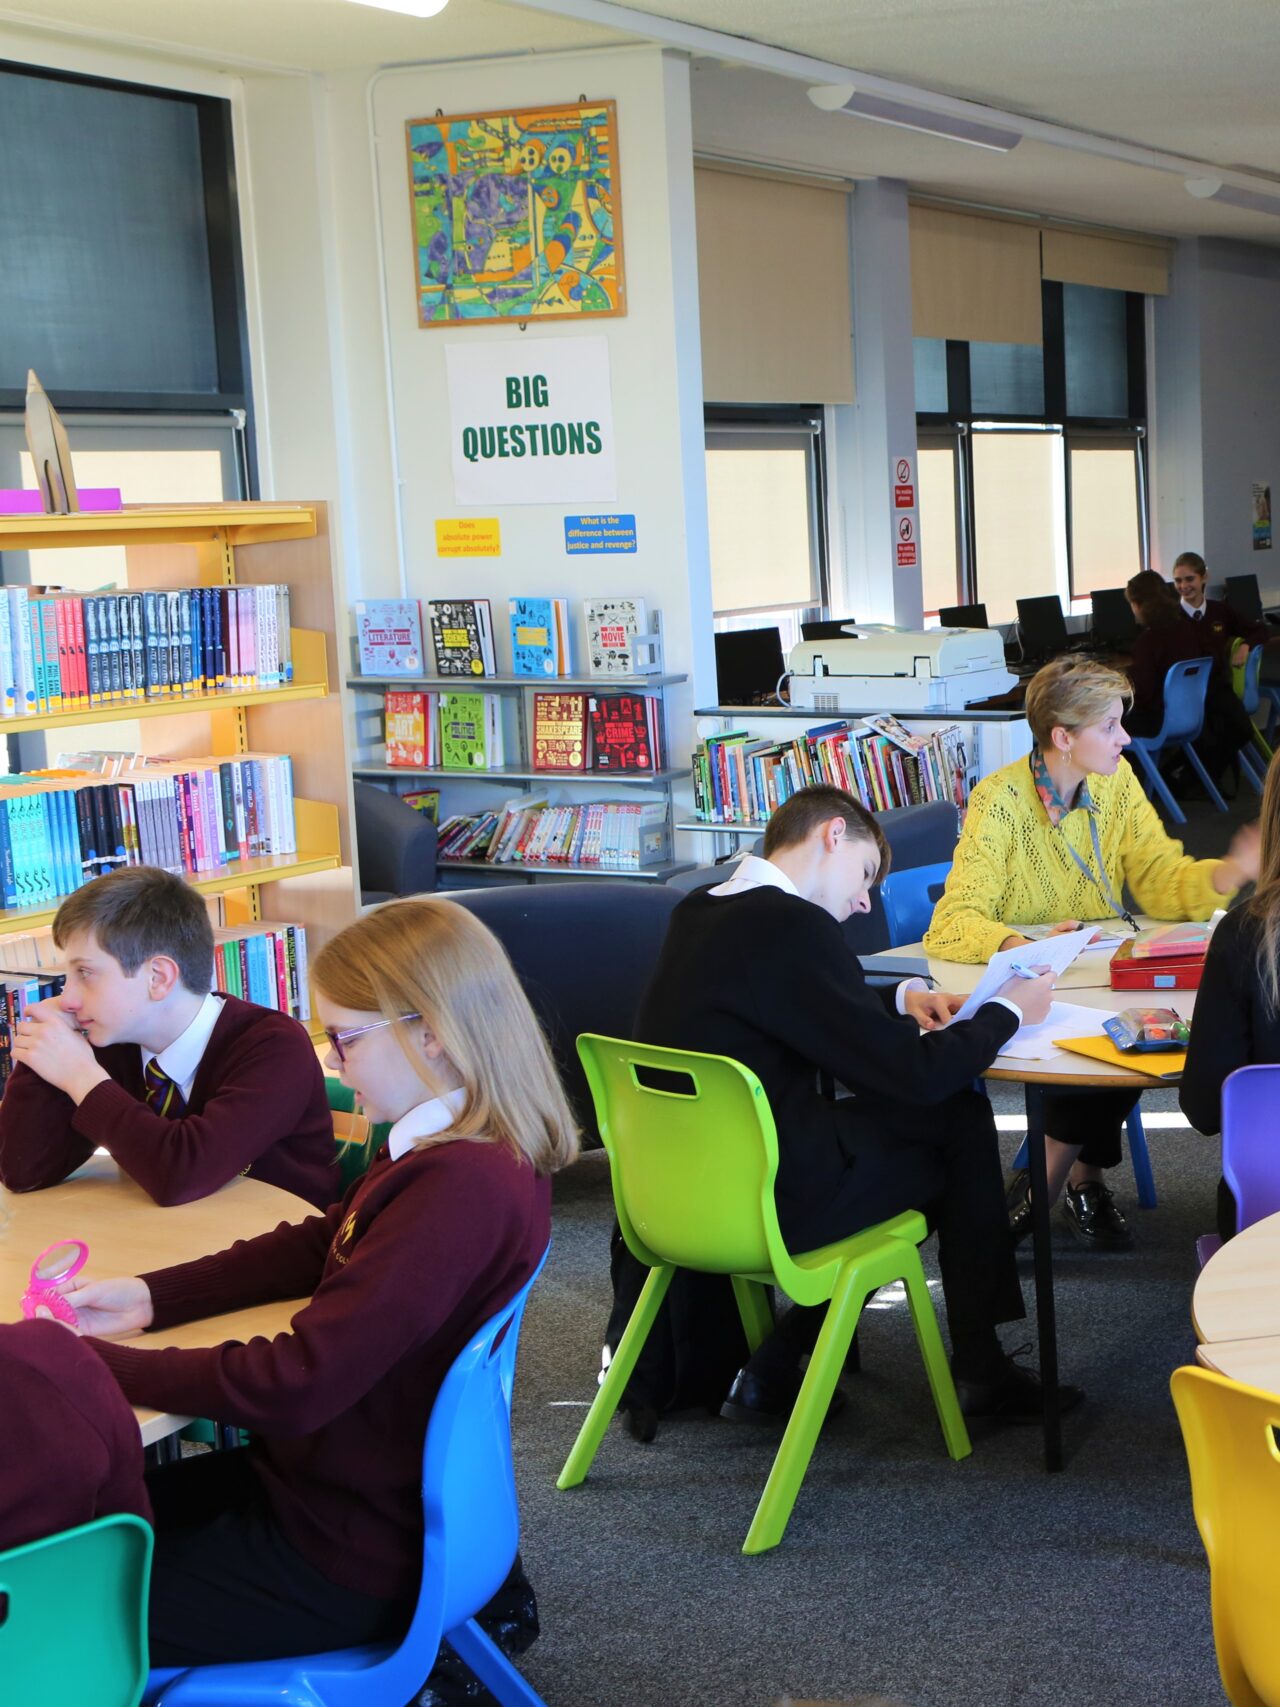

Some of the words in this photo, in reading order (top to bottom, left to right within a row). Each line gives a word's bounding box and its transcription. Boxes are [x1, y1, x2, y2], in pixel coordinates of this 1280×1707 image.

[505, 374, 549, 408] BIG
[462, 421, 603, 462] QUESTIONS
[458, 521, 475, 529] Does
[580, 517, 599, 525] What
[607, 516, 619, 524] the
[443, 533, 470, 541] absolute
[471, 533, 492, 542] power
[568, 529, 602, 537] difference
[603, 528, 634, 537] between
[437, 545, 461, 554] corrupt
[463, 544, 500, 553] absolutely?
[567, 541, 589, 550] justice
[591, 541, 603, 549] and
[605, 540, 635, 550] revenge?
[368, 632, 411, 642] LITERATURE
[601, 632, 625, 642] MOVIE
[537, 726, 582, 735] SHAKESPEARE
[606, 727, 634, 738] CRIME
[245, 764, 253, 786] VIKING
